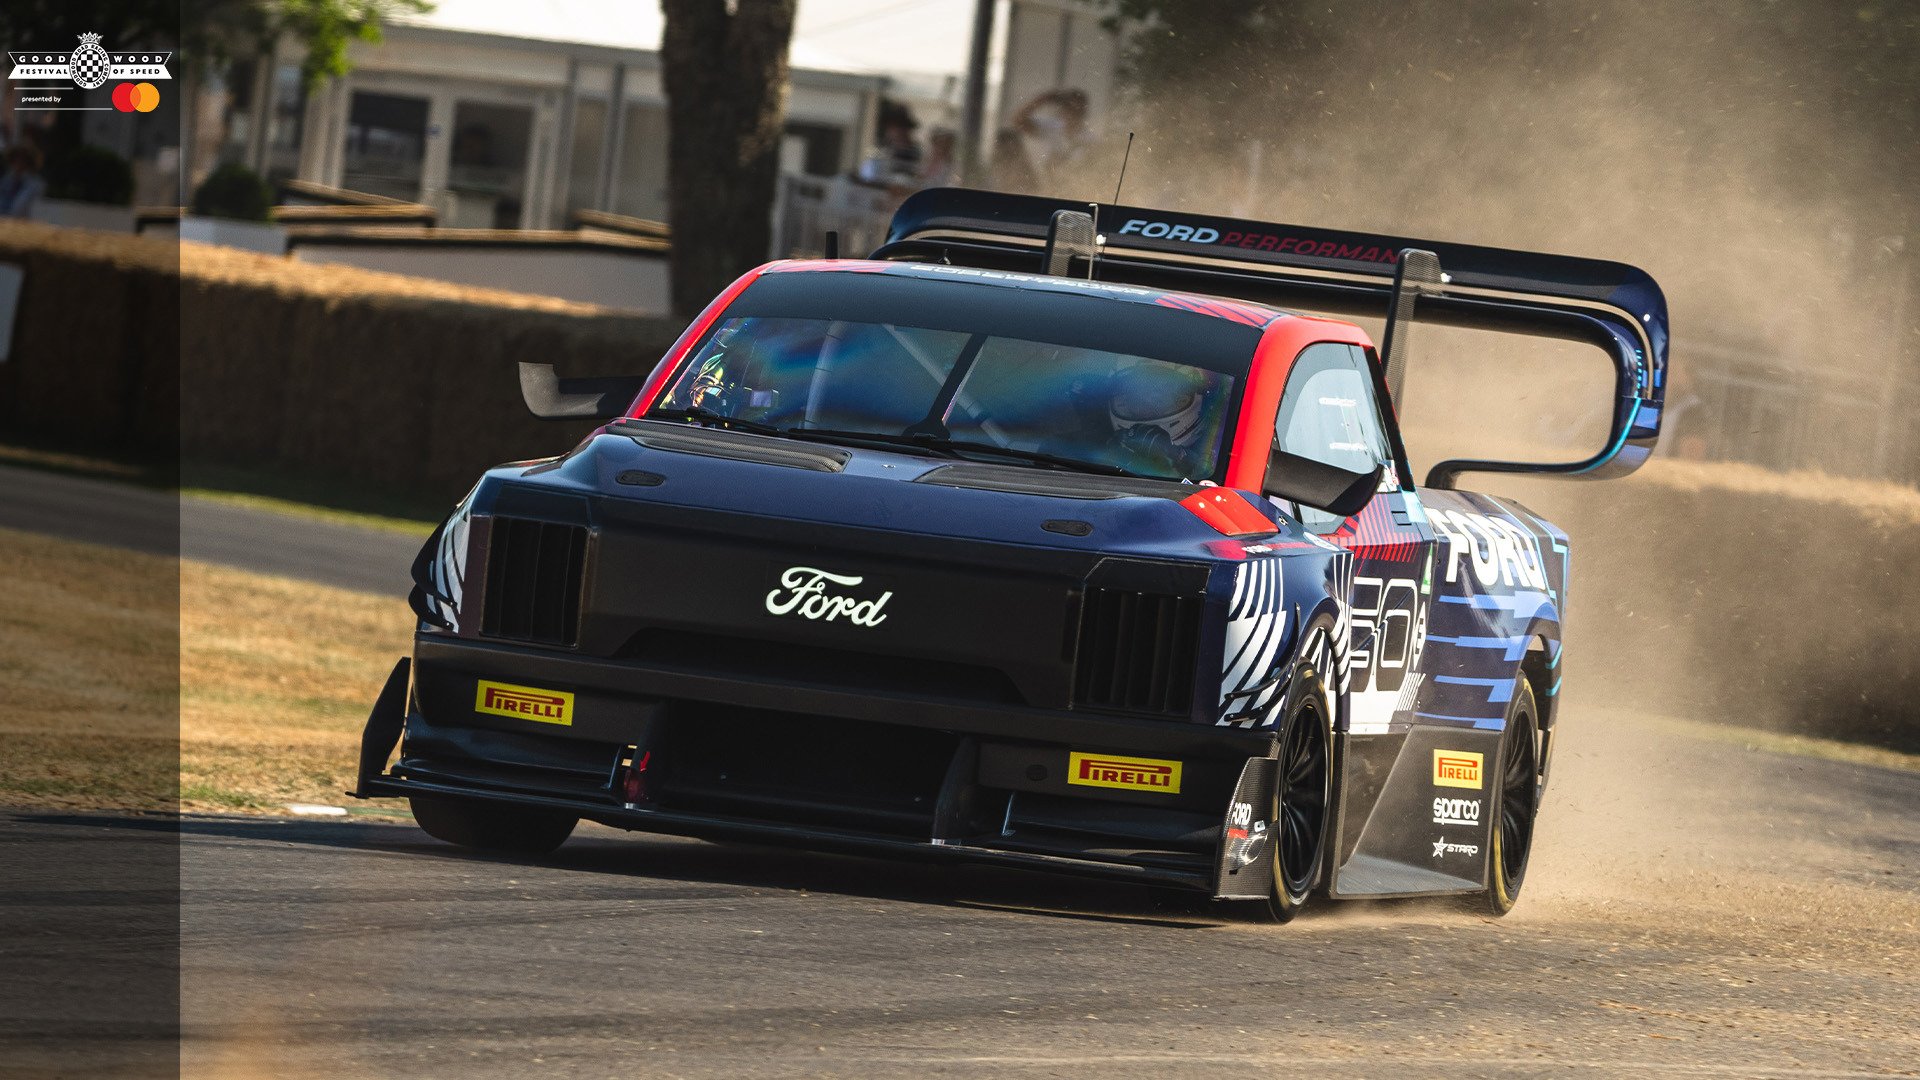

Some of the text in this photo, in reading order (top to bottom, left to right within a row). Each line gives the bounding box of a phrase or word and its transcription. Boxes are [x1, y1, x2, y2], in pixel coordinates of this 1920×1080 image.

[1119, 219, 1400, 265] FORD PERFORMAN
[1424, 508, 1546, 591] FORD
[766, 566, 893, 627] Ford
[485, 687, 566, 719] PIRELLI
[1079, 758, 1173, 787] PIRELLI
[1438, 757, 1478, 781] PIRELLI
[1230, 802, 1252, 826] FORD
[1433, 797, 1480, 825] sparco
